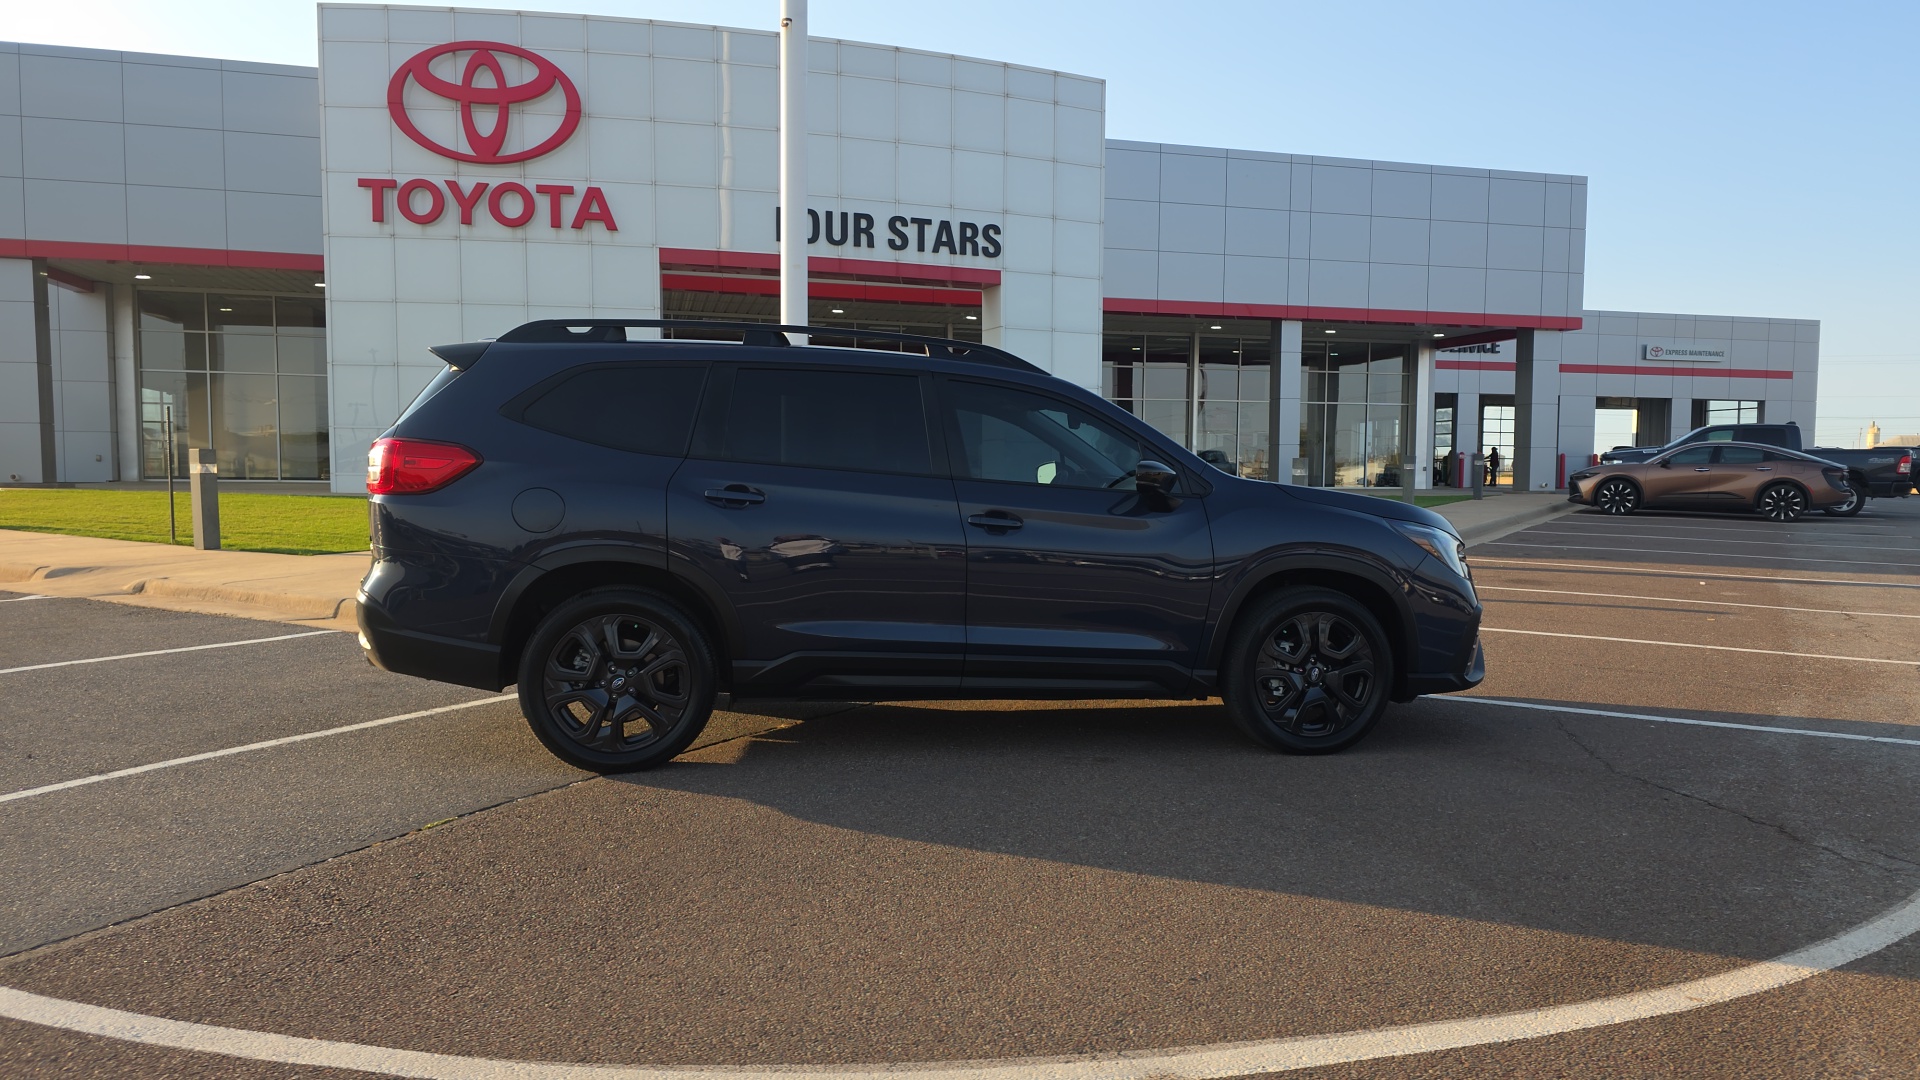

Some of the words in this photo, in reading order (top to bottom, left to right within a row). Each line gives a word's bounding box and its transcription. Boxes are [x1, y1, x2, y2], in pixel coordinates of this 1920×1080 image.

[357, 177, 619, 231] TOYOTA
[775, 206, 875, 249] OUR
[887, 215, 1002, 258] STARS
[1688, 349, 1725, 358] MAINTENANCE
